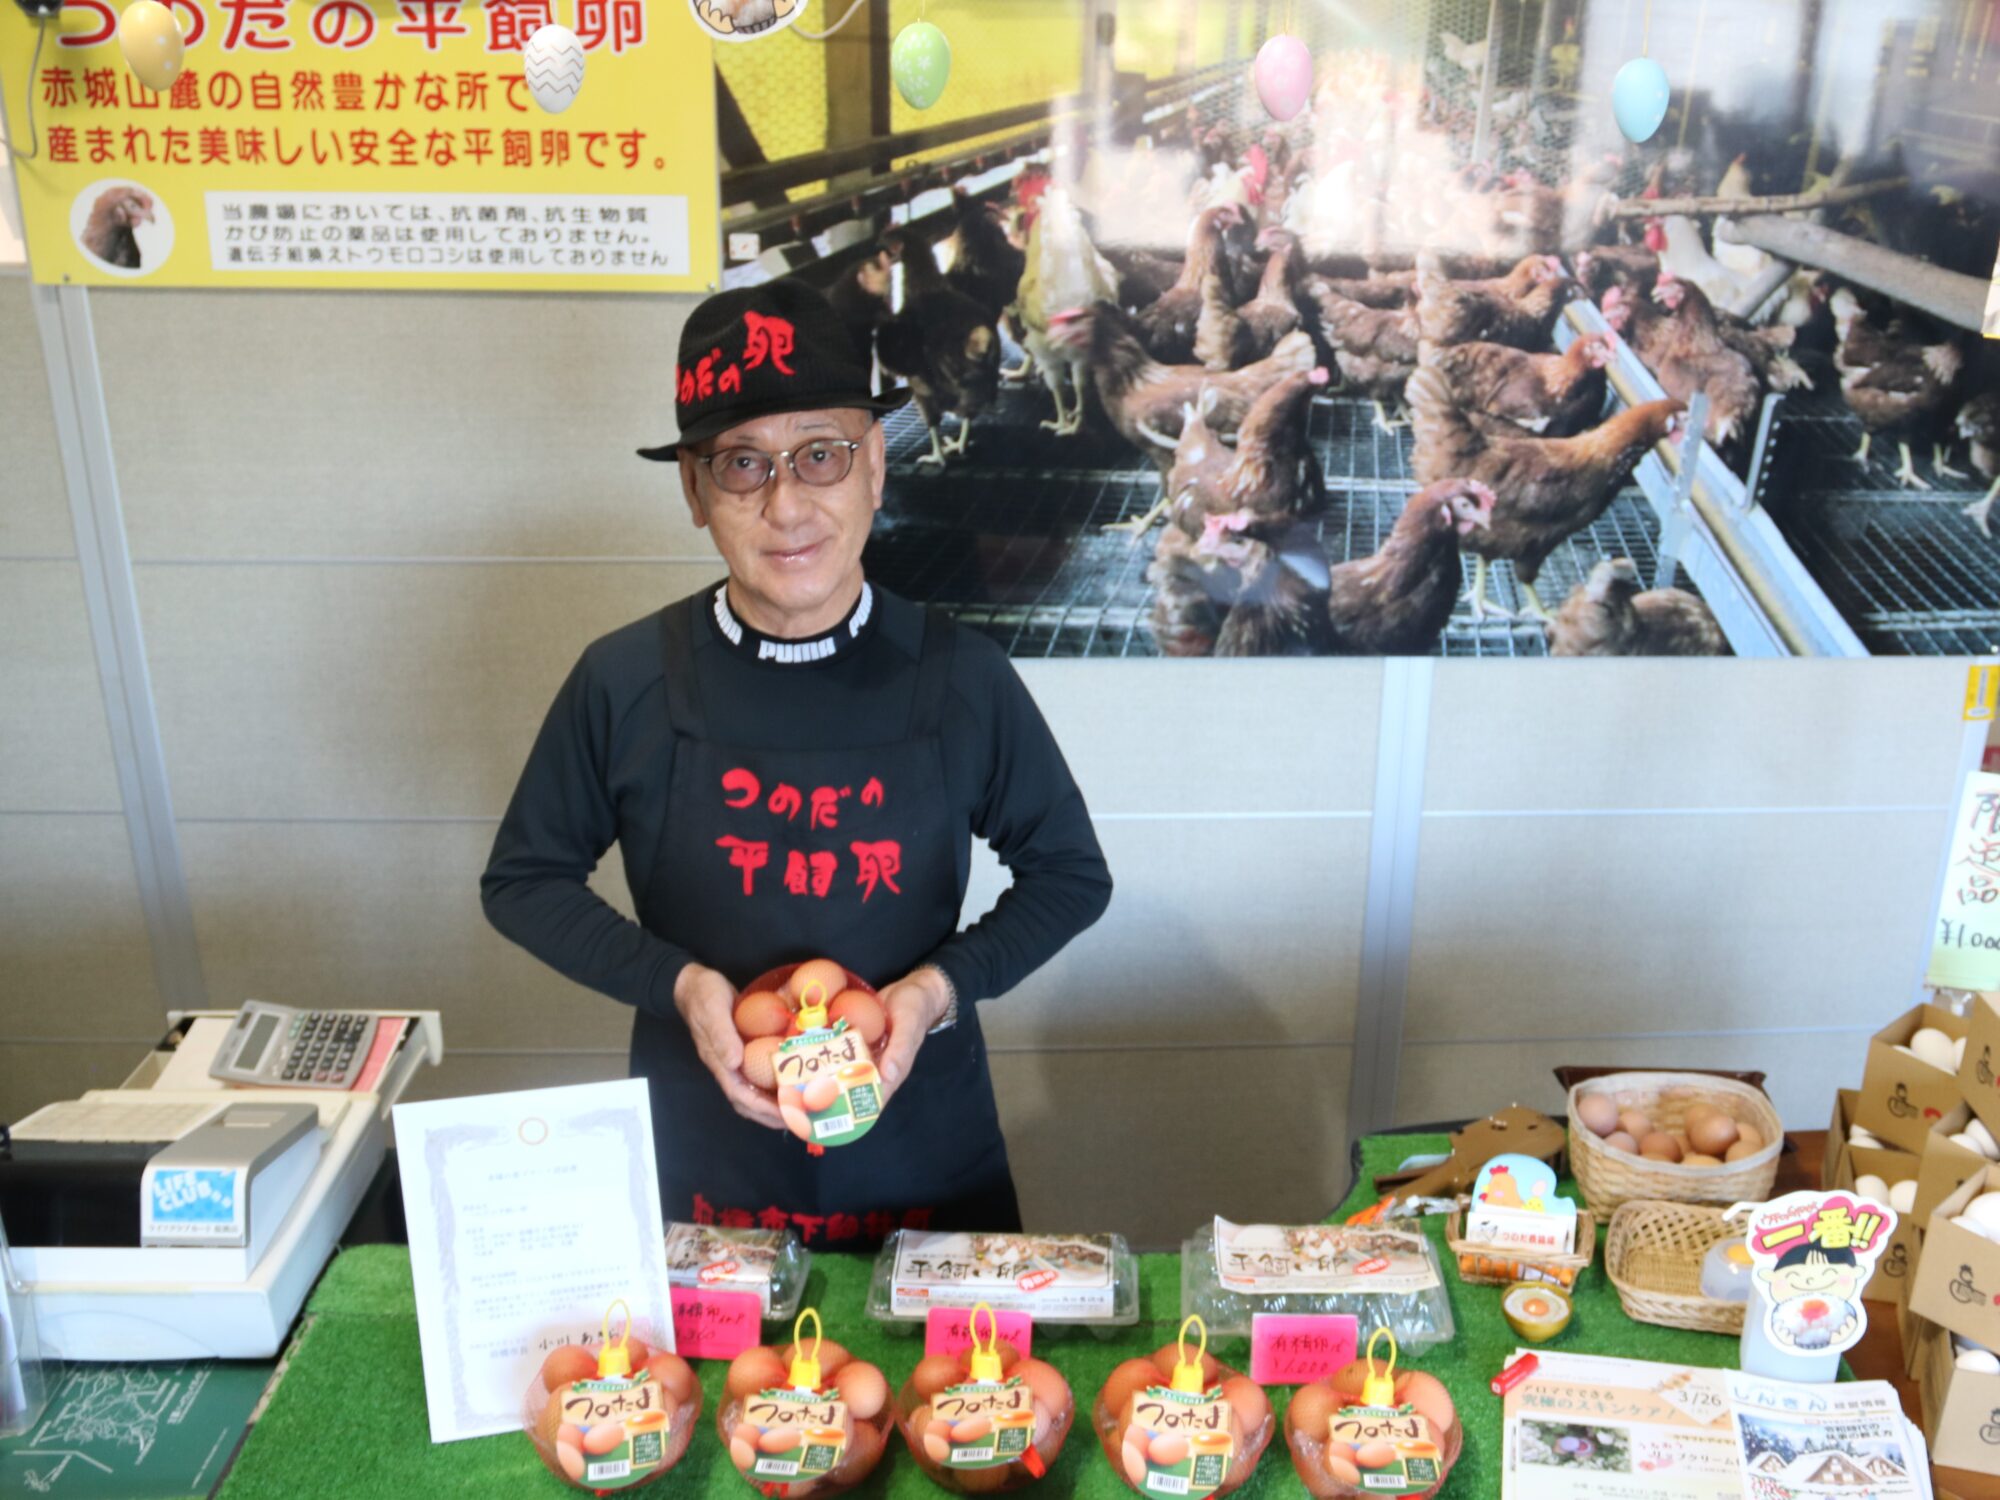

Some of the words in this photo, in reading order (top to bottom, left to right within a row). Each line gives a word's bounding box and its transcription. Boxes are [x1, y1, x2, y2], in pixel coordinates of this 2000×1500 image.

[48, 124, 667, 170] 産まれた美味しい安全な平飼卵です。
[758, 636, 837, 664] PUMA
[721, 767, 884, 831] つのだの
[153, 1170, 198, 1199] LIFE
[157, 1181, 213, 1212] CLUB
[565, 1387, 652, 1420] つのたま
[936, 1390, 1021, 1413] つのたま
[1678, 1389, 1722, 1407] 3/26
[749, 1403, 836, 1424] つのたま
[1136, 1403, 1219, 1430] つのたま
[1334, 1419, 1419, 1439] つのたま
